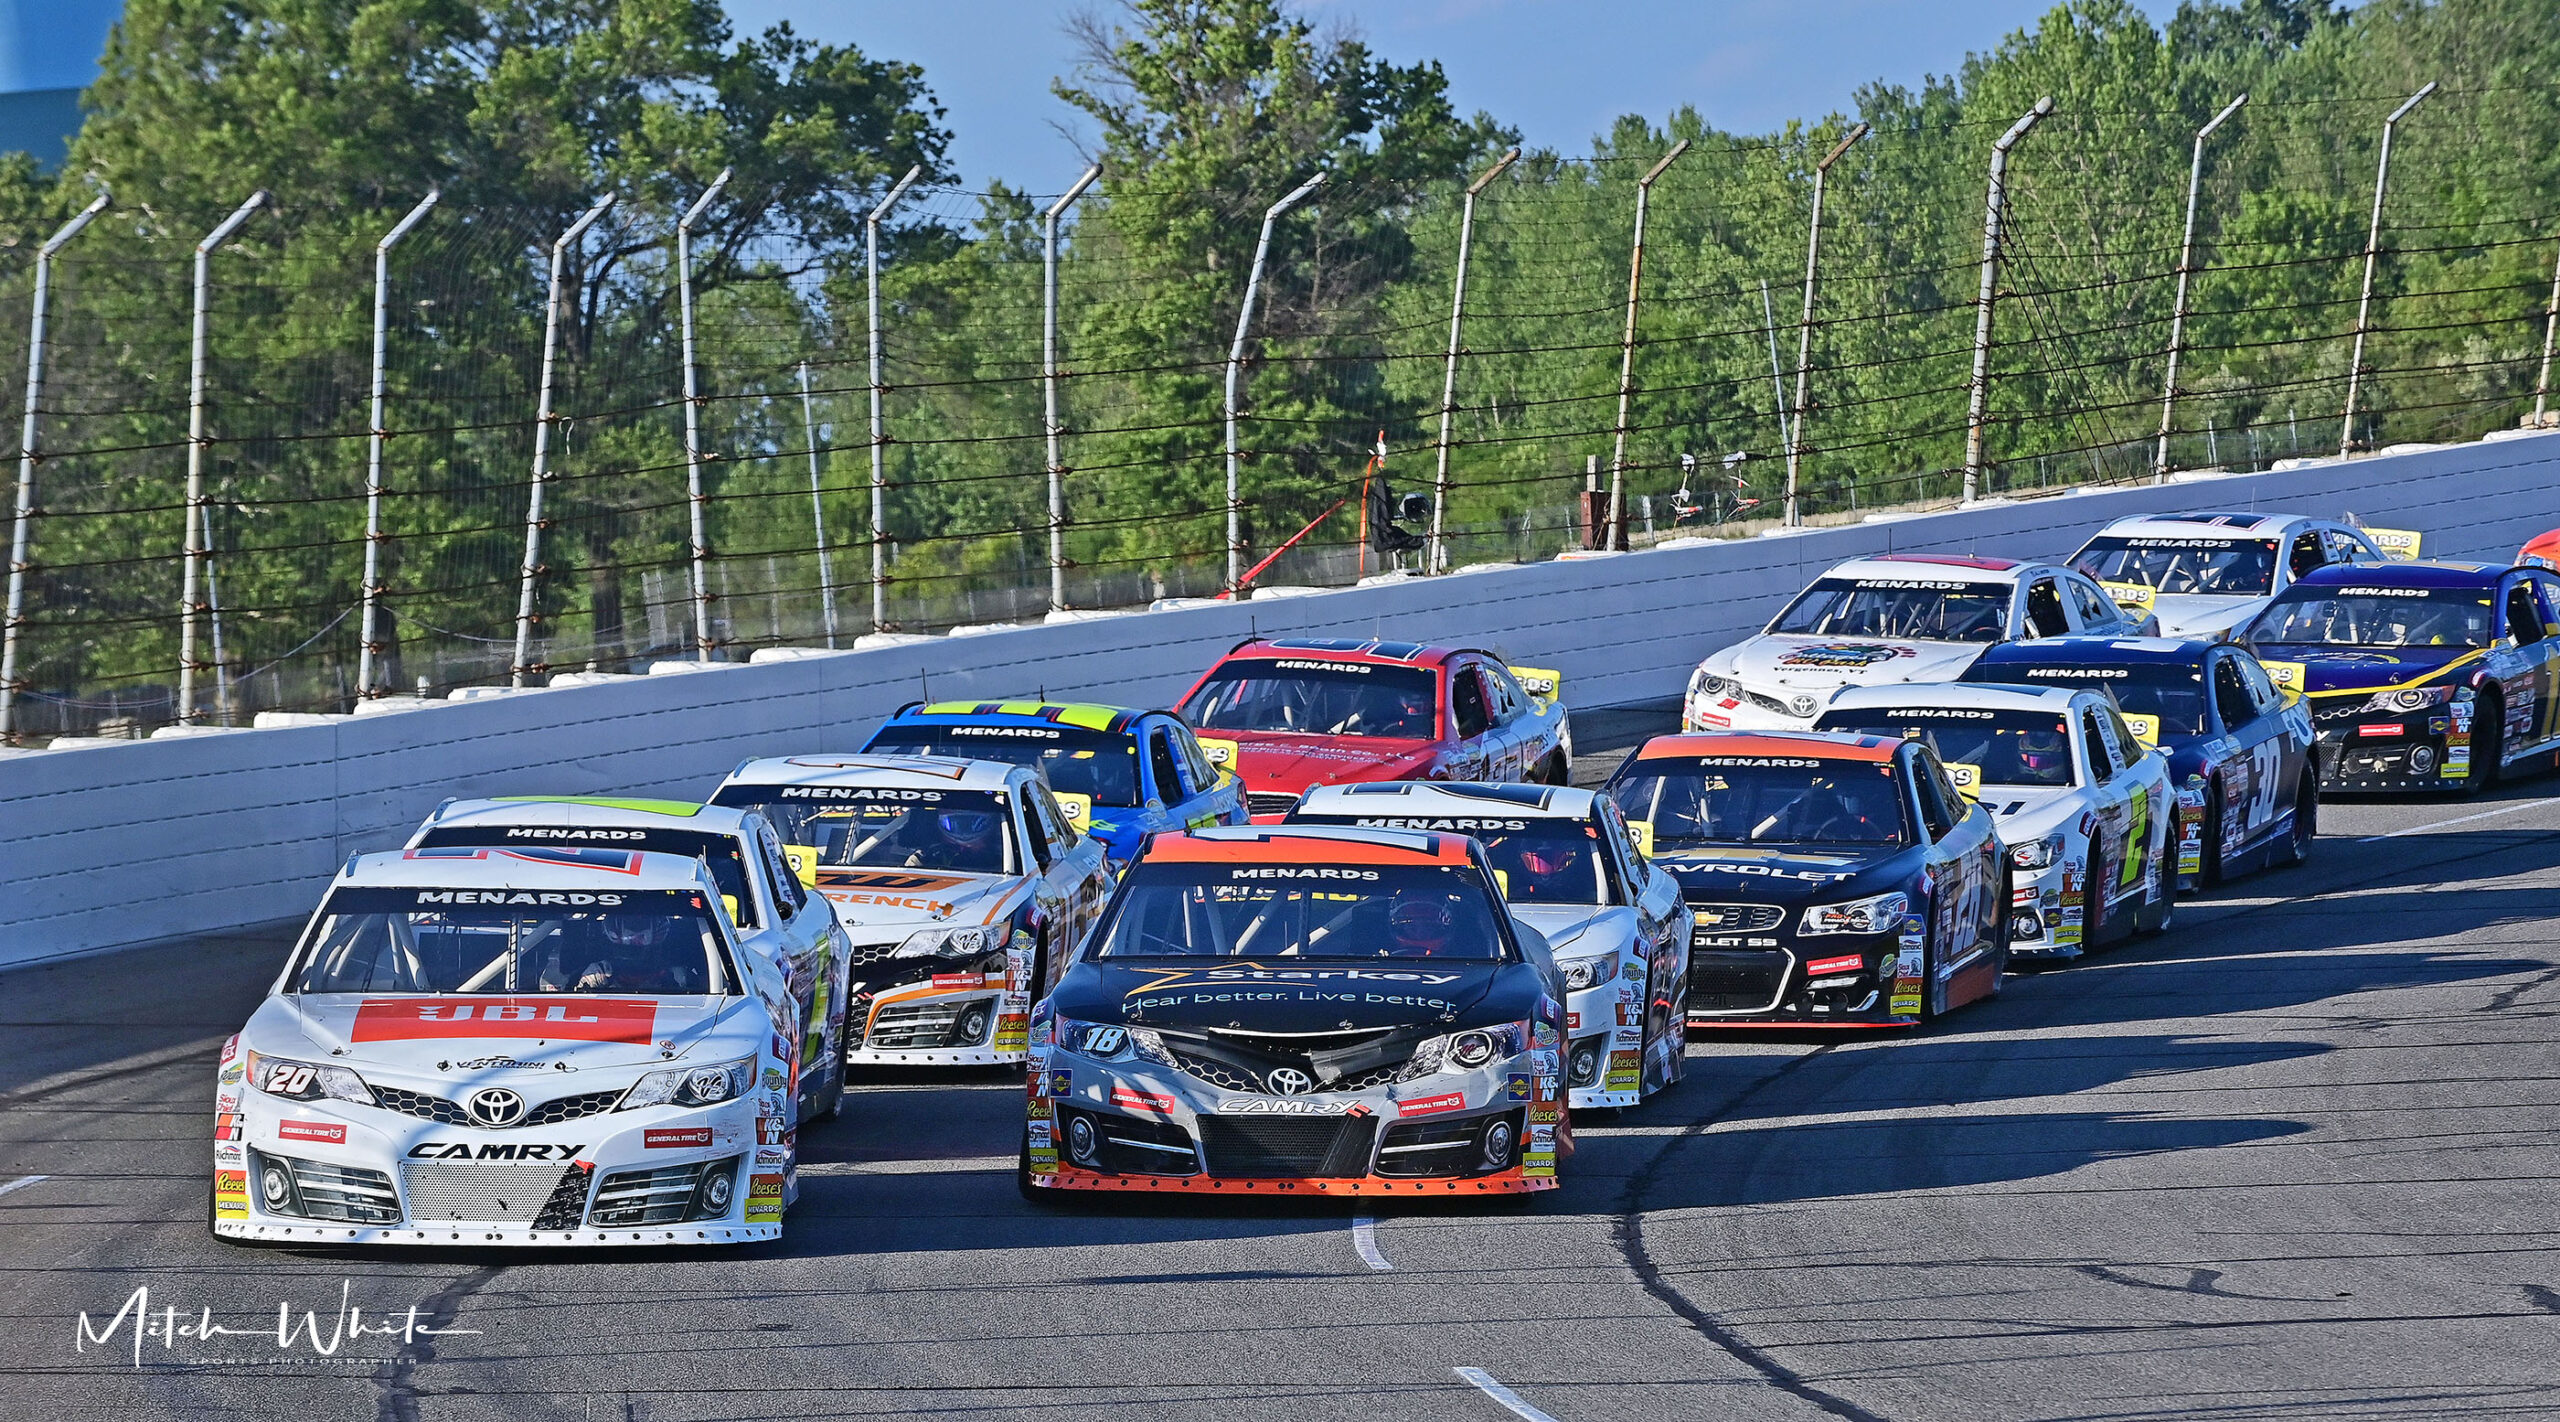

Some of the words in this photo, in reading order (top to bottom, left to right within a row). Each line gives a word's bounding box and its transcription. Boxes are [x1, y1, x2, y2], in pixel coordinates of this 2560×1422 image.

[2126, 538, 2233, 549] MENARDS
[1855, 579, 1967, 590] MENARDS
[2338, 587, 2430, 598] MENARDS
[1275, 659, 1372, 675] MENARDS
[2026, 668, 2129, 679] MENARDS
[1886, 708, 1995, 720] MENARDS
[950, 726, 1061, 740] MENARDS
[1699, 758, 1821, 769] MENARDS
[2247, 736, 2281, 830] 30
[781, 787, 943, 802] MENARDS
[1355, 818, 1526, 831] MENARDS
[506, 828, 647, 840] MENARDS
[1231, 868, 1381, 881] MENARDS
[416, 891, 623, 906] MENARDS
[1747, 938, 1777, 948] SS
[1205, 969, 1463, 985] Starkey
[1621, 965, 1646, 980] Bounty
[1014, 980, 1026, 991] N
[1122, 993, 1188, 1013] Hear
[1194, 990, 1289, 1004] better.
[1299, 990, 1357, 1002] Live
[418, 1005, 599, 1023] JBL
[1625, 1015, 1637, 1026] N
[1083, 1027, 1125, 1052] 18
[1611, 1053, 1640, 1069] Reese's
[265, 1065, 319, 1094] 20
[762, 1072, 788, 1089] Bounty
[1539, 1076, 1558, 1089] K&
[1036, 1085, 1048, 1097] N
[1541, 1089, 1555, 1101] N
[1112, 1093, 1143, 1104] GENERAL
[1143, 1099, 1158, 1107] TIRE
[1217, 1098, 1361, 1115] CAMRY
[1528, 1104, 1558, 1122] Reese's
[764, 1117, 785, 1131] K&
[229, 1127, 240, 1141] N
[281, 1127, 312, 1136] GENERAL
[647, 1135, 680, 1143] GENERAL
[680, 1134, 698, 1142] TIRE
[766, 1132, 779, 1145] N
[407, 1142, 587, 1160] CAMRY
[1525, 1158, 1555, 1168] MENARDS
[216, 1171, 246, 1193] Reese's
[751, 1177, 782, 1195] Reese's
[747, 1204, 779, 1213] MENARDS
